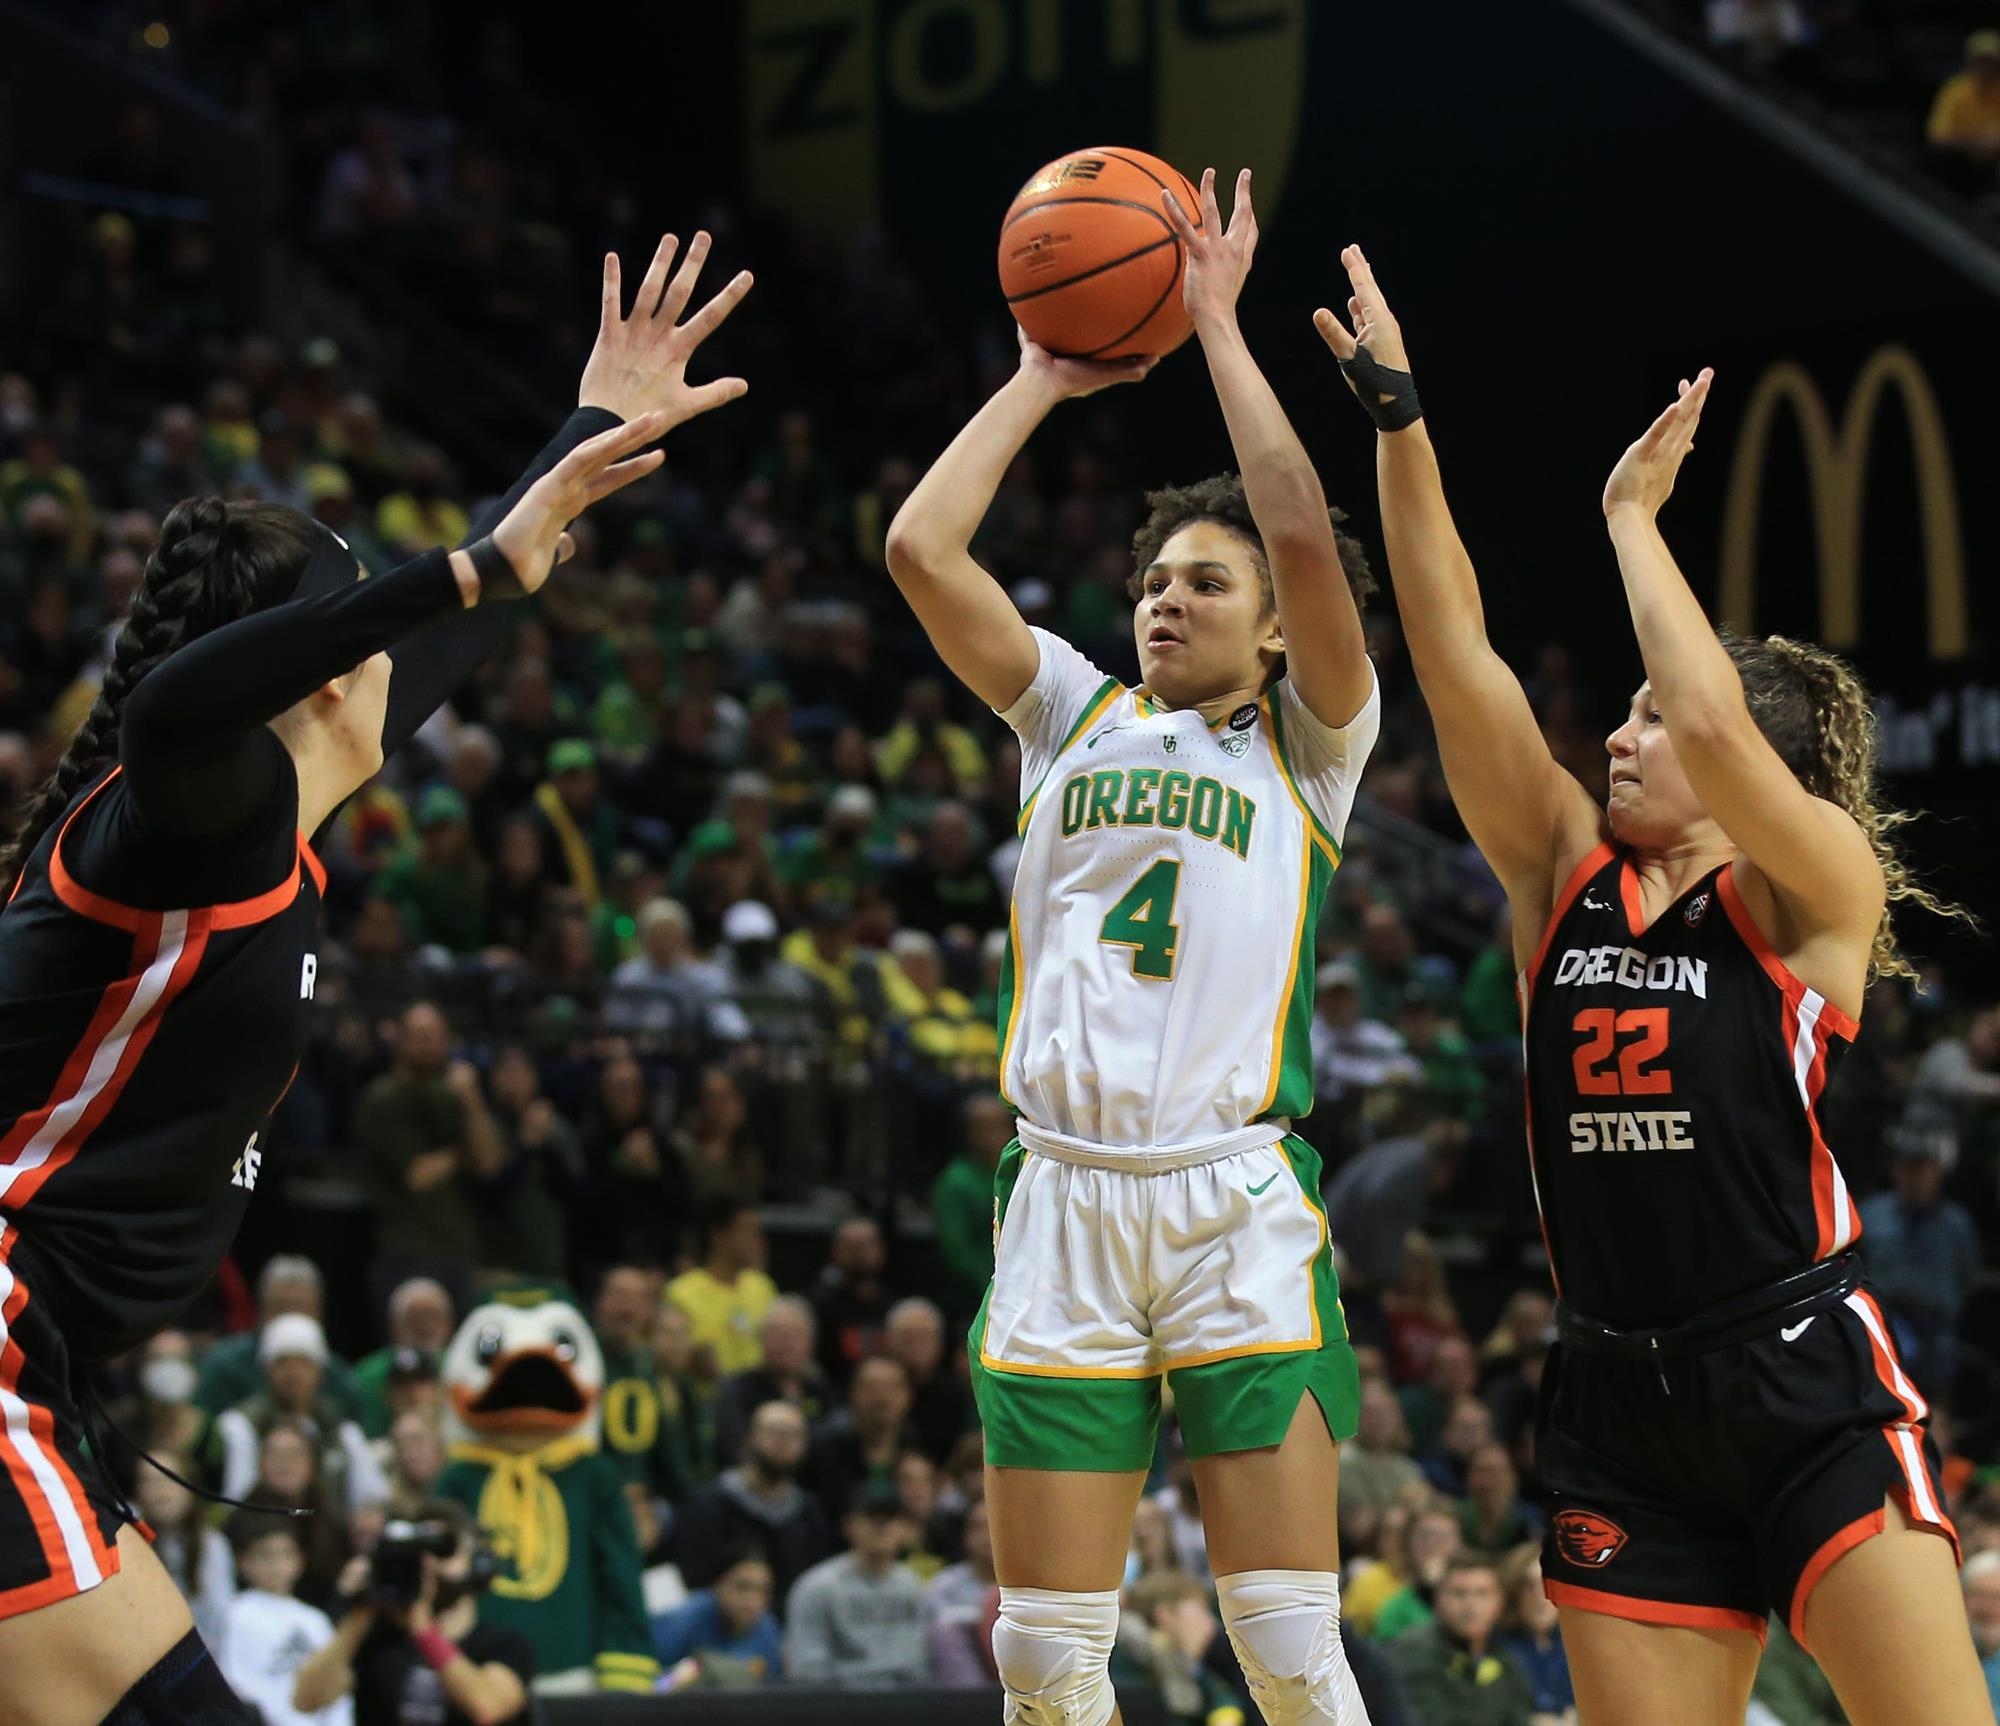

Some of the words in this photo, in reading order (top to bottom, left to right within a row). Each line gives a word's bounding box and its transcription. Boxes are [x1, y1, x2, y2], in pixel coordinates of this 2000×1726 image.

[1062, 768, 1257, 862] OREGON
[1098, 856, 1184, 982] 4
[1554, 944, 1709, 1000] OREGON
[1571, 1007, 1673, 1096] 22
[1569, 1110, 1695, 1153] STATE
